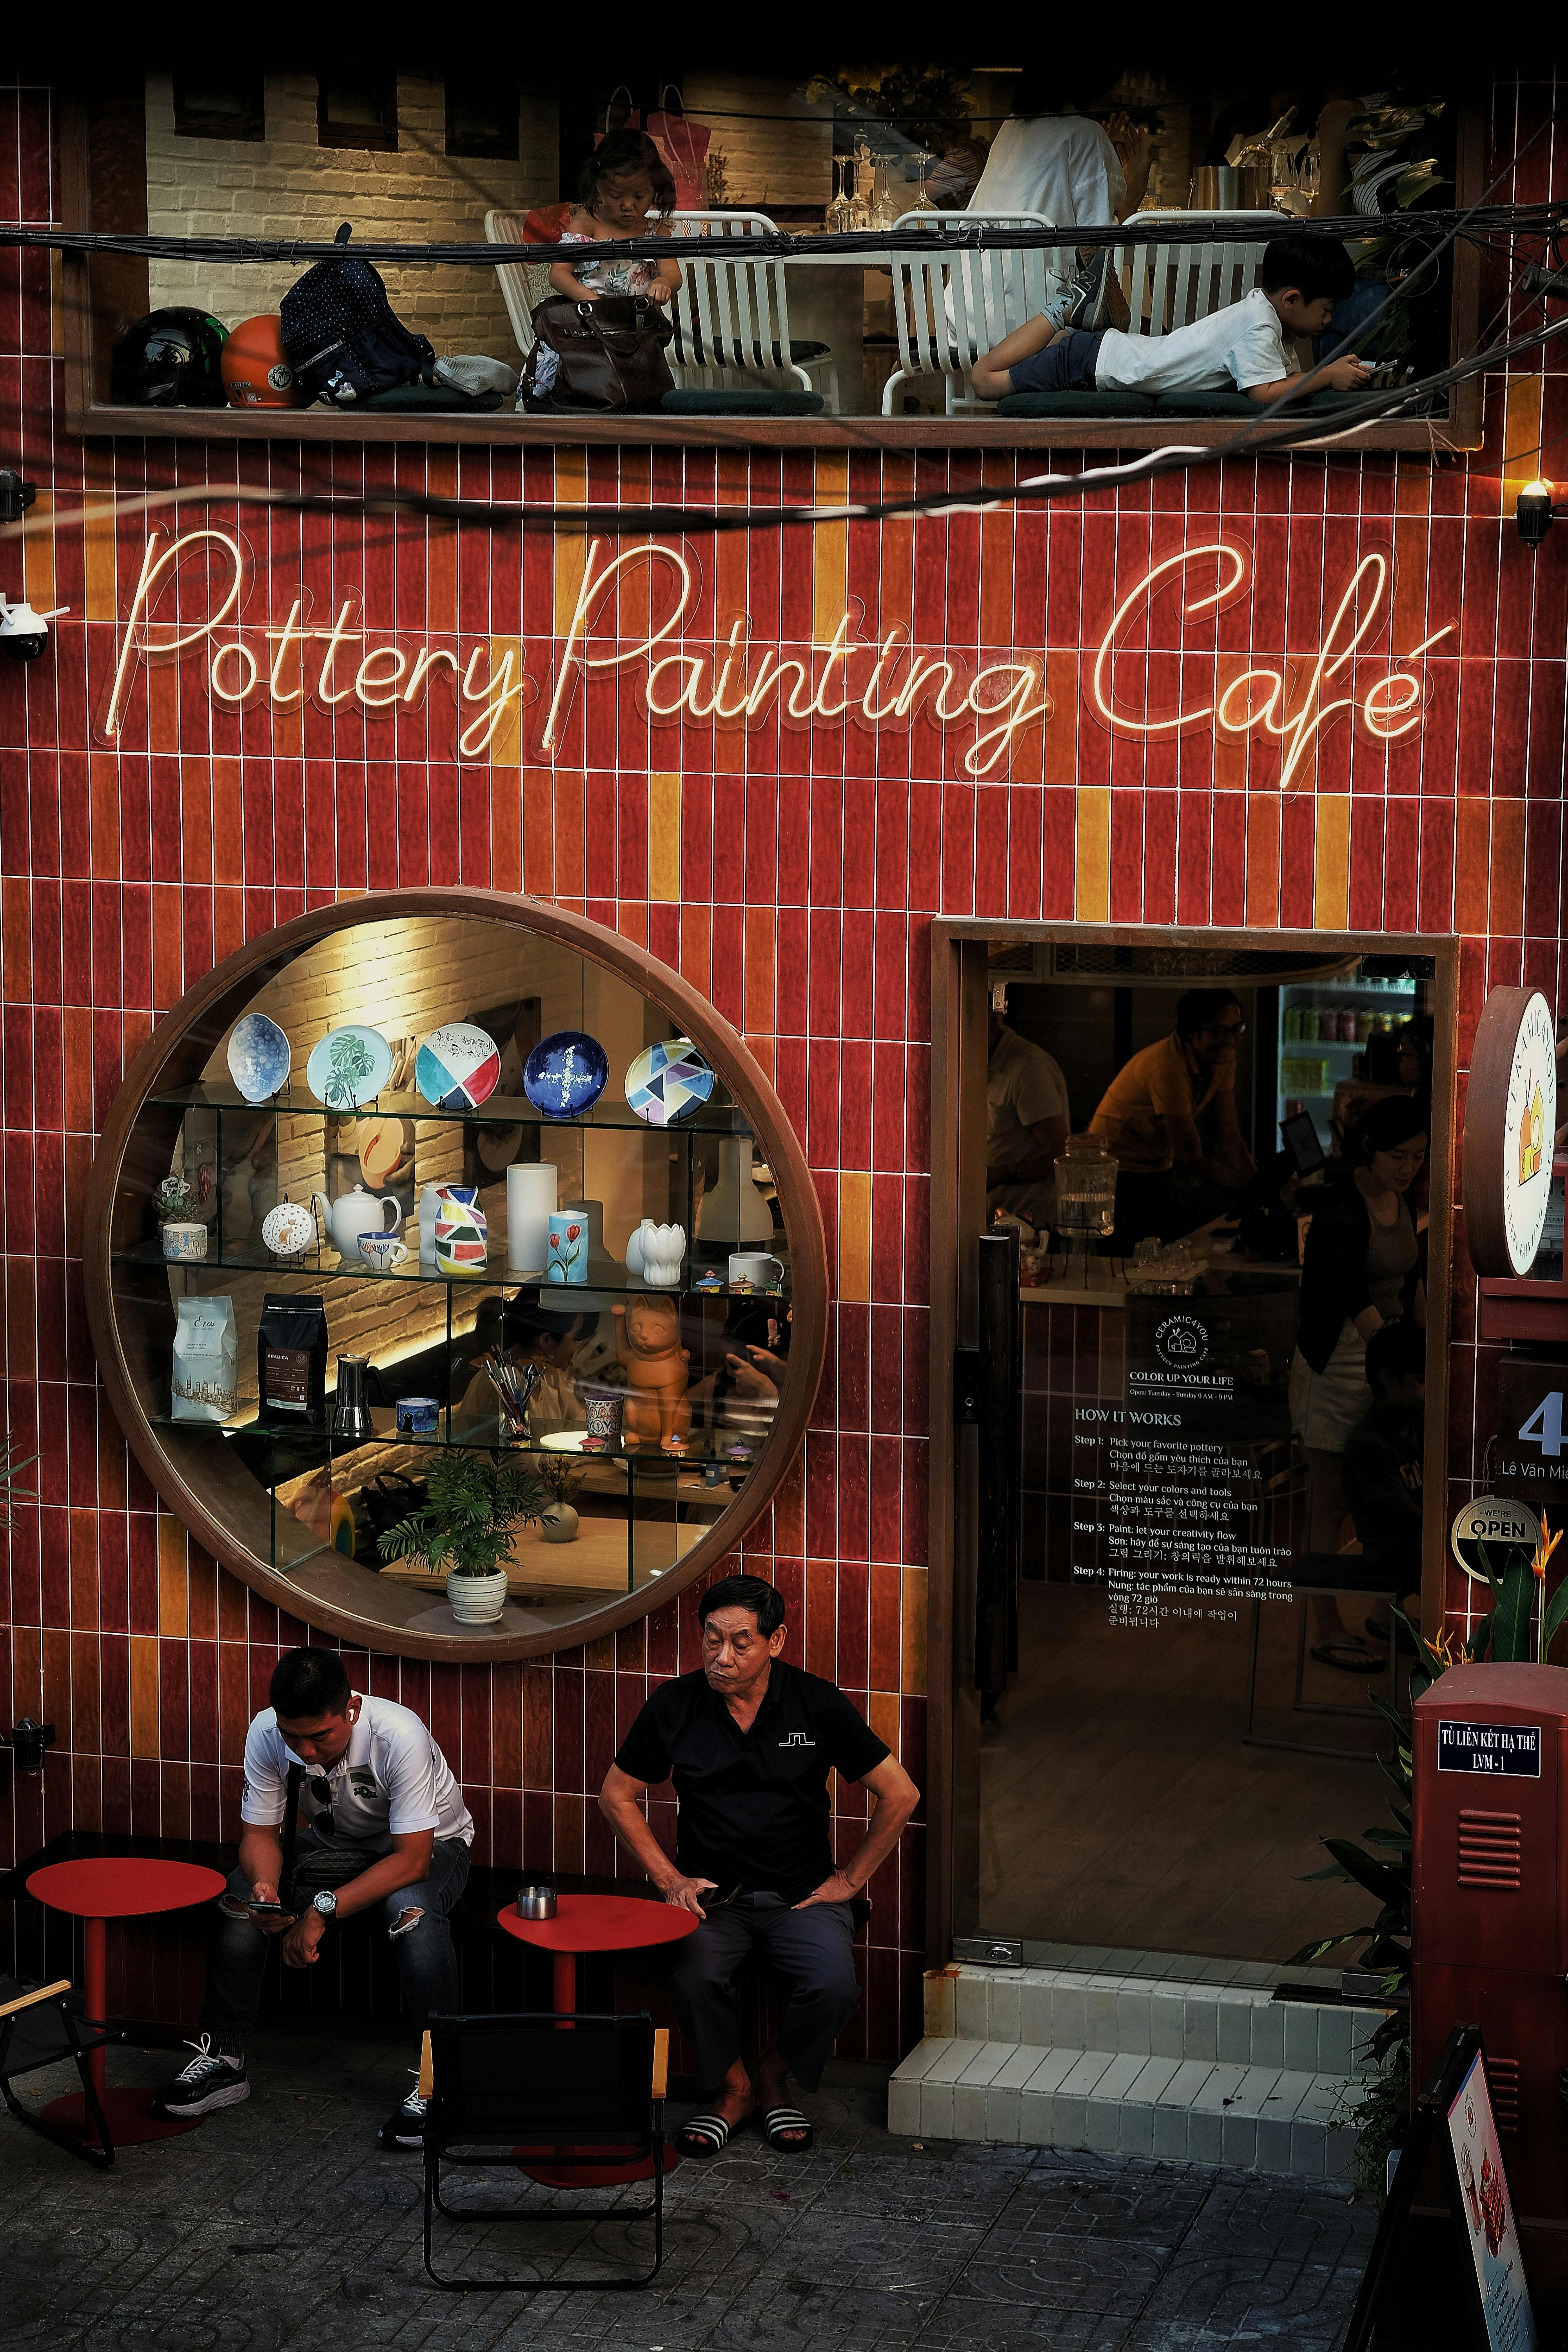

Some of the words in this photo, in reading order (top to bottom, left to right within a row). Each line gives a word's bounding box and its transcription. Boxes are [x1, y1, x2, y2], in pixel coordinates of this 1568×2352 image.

[106, 530, 524, 756] Pottery
[543, 539, 1047, 775] Painting
[1094, 544, 1454, 788] Café
[194, 1315, 215, 1327] Eros
[1156, 1316, 1209, 1341] CERAMIC4YOU
[1156, 1345, 1172, 1365] POTTERY
[1174, 1361, 1199, 1369] PAINTING
[1130, 1372, 1164, 1382] COLOR
[1167, 1374, 1180, 1382] UP
[1182, 1374, 1210, 1385] YOUR
[1212, 1376, 1234, 1385] LIFE
[1075, 1408, 1109, 1422] HOW
[1114, 1411, 1126, 1423] IT
[1129, 1411, 1181, 1426] WORKS
[1519, 1392, 1568, 1456] 4
[1075, 1435, 1095, 1446] Step
[1098, 1437, 1103, 1445] 1:
[1110, 1437, 1129, 1446] Pick
[1130, 1440, 1151, 1449] your
[1154, 1440, 1187, 1450] favorite
[1190, 1443, 1223, 1454] pottery
[1110, 1450, 1133, 1460] Chọn
[1149, 1452, 1167, 1462] gốm
[1170, 1454, 1186, 1463] yêu
[1189, 1455, 1211, 1465] thích
[1213, 1456, 1229, 1465] của
[1231, 1457, 1248, 1467] bạn
[1110, 1461, 1140, 1473] 마음에
[1143, 1463, 1163, 1474] 드는
[1167, 1464, 1207, 1477] 도자기를
[1211, 1467, 1262, 1480] 골라보세요
[1502, 1461, 1517, 1475] Lê
[1521, 1463, 1544, 1477] Văn
[1074, 1479, 1095, 1489] Step
[1098, 1480, 1105, 1488] 2:
[1109, 1481, 1136, 1490] Select
[1138, 1485, 1159, 1493] your
[1161, 1485, 1189, 1494] colors
[1210, 1488, 1231, 1497] tools
[1109, 1493, 1132, 1504] Chọn
[1135, 1496, 1153, 1504] màu
[1156, 1495, 1171, 1505] sắc
[1174, 1497, 1183, 1506] và
[1186, 1499, 1207, 1509] công
[1210, 1501, 1221, 1510] cụ
[1223, 1501, 1238, 1510] của
[1241, 1502, 1257, 1512] bạn
[1110, 1504, 1140, 1516] 색상과
[1143, 1507, 1174, 1518] 도구를
[1178, 1509, 1229, 1521] 선택하세요
[1485, 1509, 1512, 1517] WE'RE
[1074, 1522, 1094, 1532] Step
[1097, 1523, 1105, 1532] 3:
[1109, 1524, 1134, 1534] Paint:
[1136, 1526, 1147, 1534] let
[1149, 1528, 1170, 1537] your
[1172, 1529, 1214, 1540] creativity
[1217, 1531, 1236, 1540] flow
[1471, 1519, 1526, 1538] OPEN
[1109, 1536, 1128, 1545] Sơn:
[1130, 1537, 1146, 1548] hãy
[1149, 1538, 1159, 1547] để
[1161, 1541, 1172, 1550] sự
[1174, 1541, 1194, 1552] sáng
[1197, 1543, 1211, 1553] tạo
[1214, 1543, 1229, 1552] của
[1231, 1544, 1248, 1554] bạn
[1251, 1546, 1270, 1555] tuôn
[1274, 1548, 1291, 1556] trào
[1109, 1548, 1128, 1558] 그림
[1133, 1549, 1167, 1561] 그리기:
[1171, 1551, 1211, 1564] 창의력을
[1216, 1554, 1277, 1567] 발휘해보세요
[1073, 1566, 1094, 1577] Step
[1109, 1568, 1136, 1579] Firing:
[1138, 1572, 1159, 1580] your
[1161, 1573, 1184, 1581] work
[1187, 1573, 1193, 1581] is
[1196, 1575, 1221, 1585] ready
[1223, 1576, 1250, 1585] within
[1253, 1578, 1264, 1586] 72
[1267, 1578, 1292, 1588] hours
[1108, 1593, 1129, 1603] vòng
[1131, 1594, 1142, 1602] 72
[1144, 1595, 1158, 1604] giờ
[1109, 1580, 1134, 1591] Nung:
[1136, 1583, 1150, 1591] tác
[1152, 1583, 1176, 1593] phẩm
[1179, 1585, 1194, 1593] của
[1197, 1586, 1213, 1596] bạn
[1216, 1588, 1225, 1596] sẽ
[1228, 1588, 1243, 1597] sẵn
[1246, 1590, 1266, 1600] sàng
[1269, 1591, 1293, 1602] trong
[1108, 1615, 1160, 1628] 준비됩니다
[1109, 1603, 1131, 1614] 실행:
[1136, 1606, 1169, 1617] 72시간
[1173, 1606, 1202, 1619] 이내에
[1207, 1609, 1236, 1622] 작업이
[1442, 1726, 1454, 1744] TỦ
[1457, 1727, 1478, 1746] LIÊN
[1481, 1729, 1499, 1748] KẾT
[1501, 1734, 1515, 1753] HẠ
[1517, 1731, 1535, 1750] THẾ
[1473, 1754, 1493, 1769] LVM
[1501, 1756, 1504, 1770] 1
